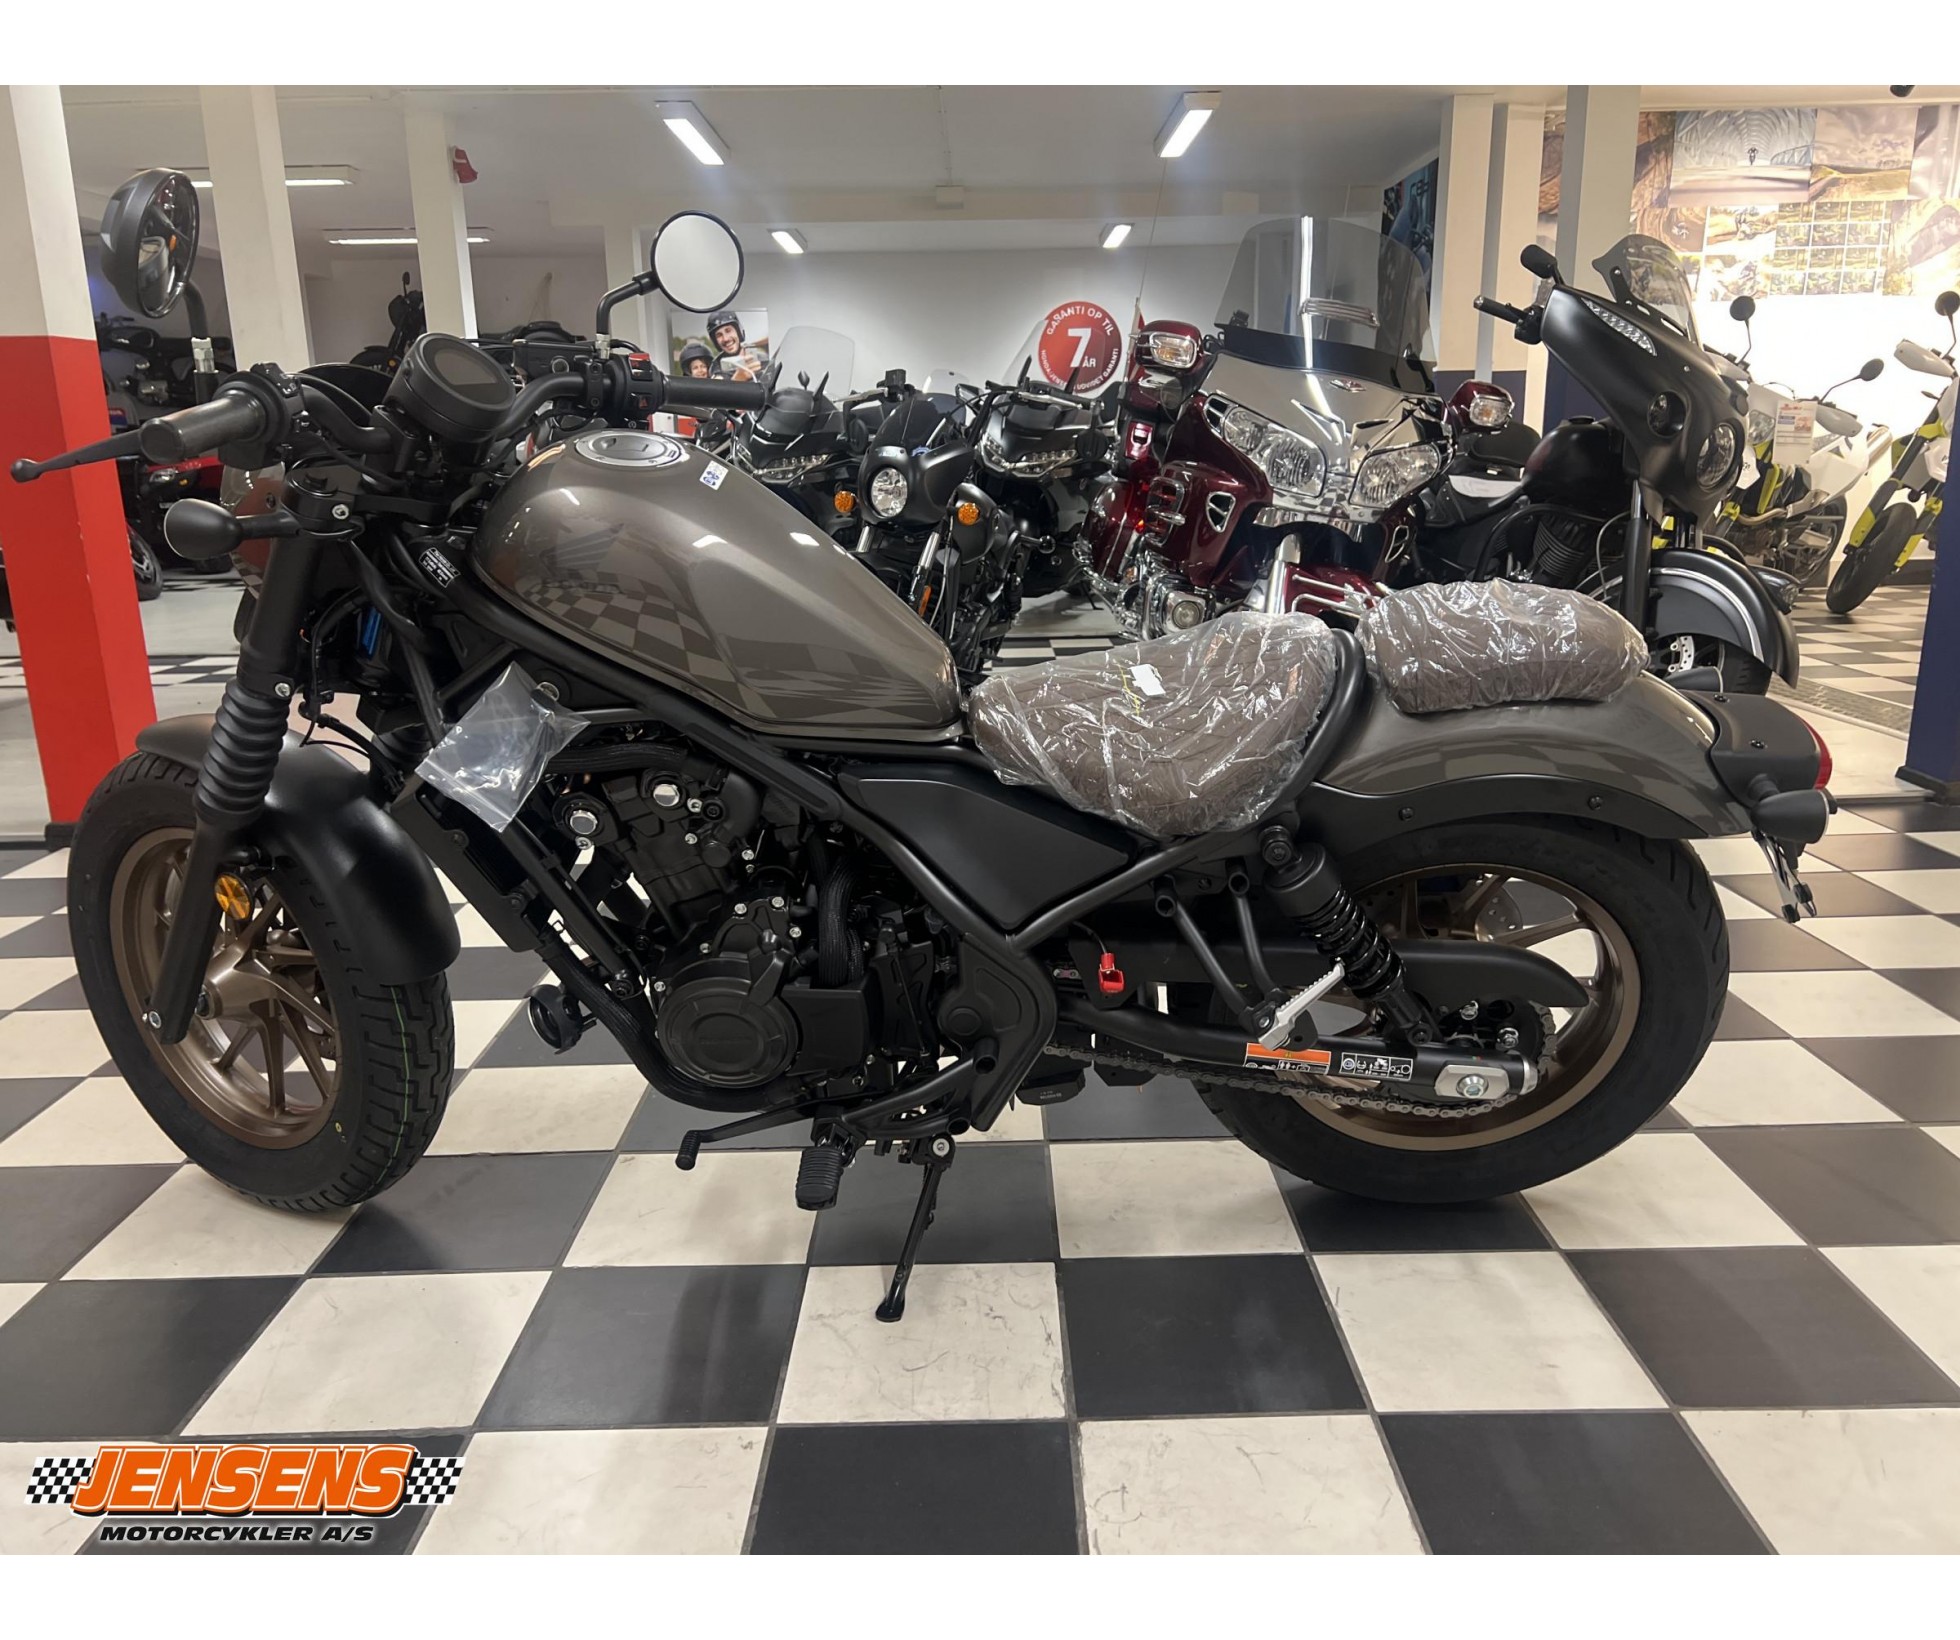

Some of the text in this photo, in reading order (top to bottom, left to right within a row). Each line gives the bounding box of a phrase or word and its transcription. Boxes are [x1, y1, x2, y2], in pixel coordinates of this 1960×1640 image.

[1046, 305, 1115, 336] GARANTI OP TIL
[1067, 327, 1092, 368] 7
[1082, 355, 1097, 368] ÅR
[1102, 348, 1119, 377] GARANTI
